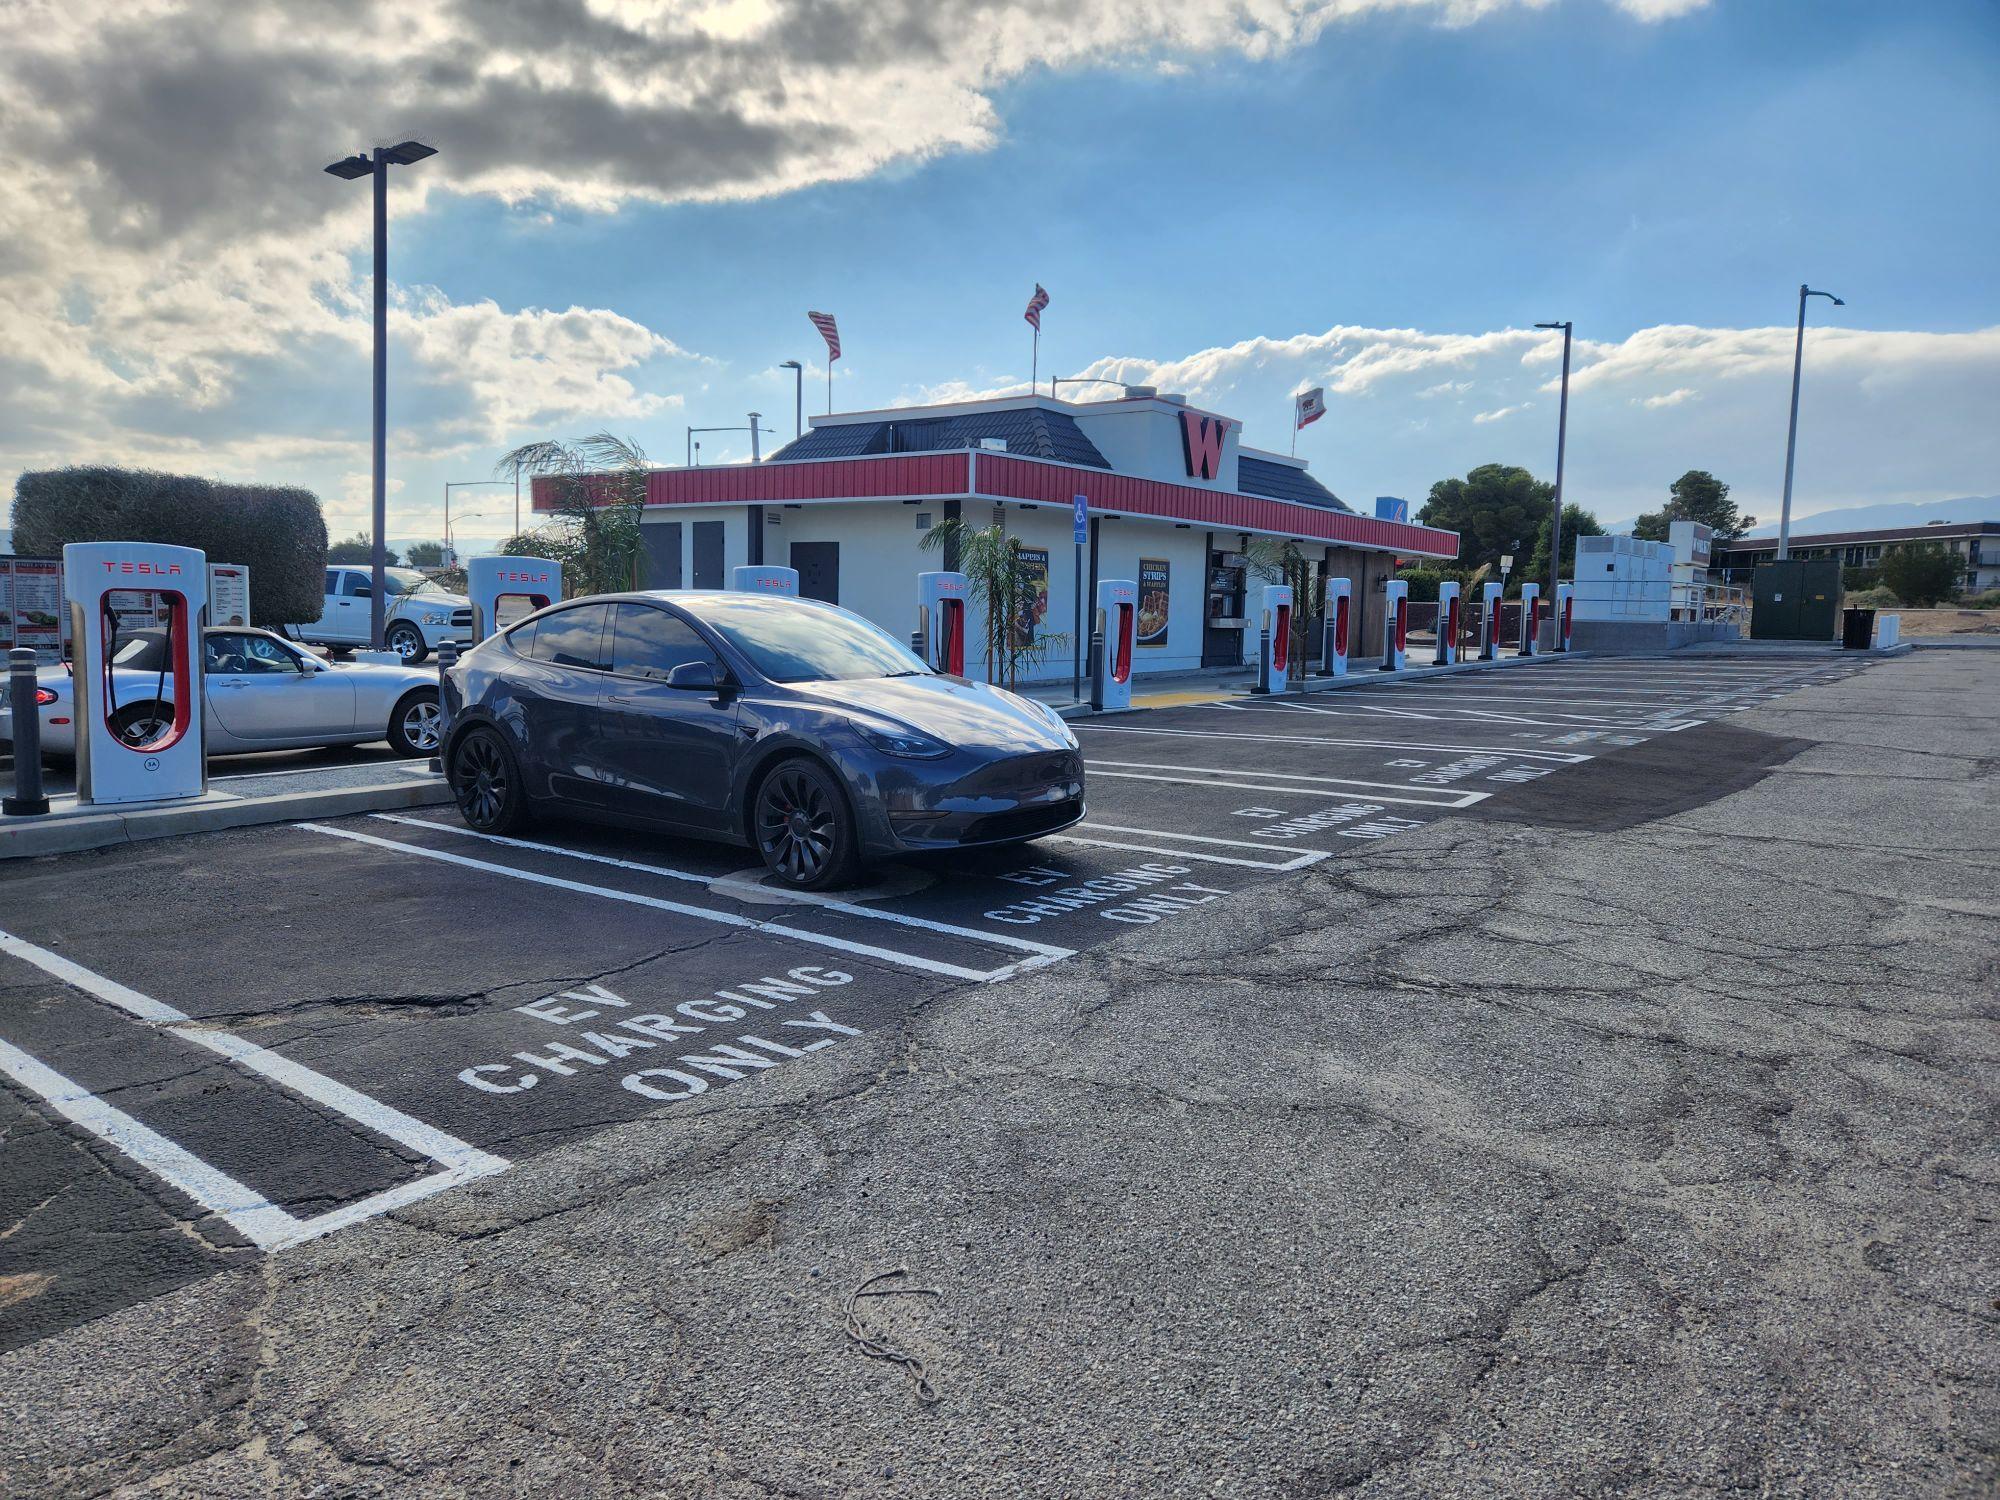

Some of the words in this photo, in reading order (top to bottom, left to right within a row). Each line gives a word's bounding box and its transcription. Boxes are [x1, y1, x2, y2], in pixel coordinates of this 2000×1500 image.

[1178, 411, 1231, 479] W
[102, 562, 181, 575] TESLA
[497, 572, 548, 583] TESLA
[1142, 571, 1167, 581] STRIPS
[1143, 563, 1167, 572] CHICKEN
[756, 579, 792, 588] TESLA
[1409, 754, 1508, 784] CHARGING
[1486, 764, 1557, 783] ONLY
[1230, 806, 1290, 819] EV
[1249, 803, 1385, 839] CHARGING
[1336, 816, 1429, 839] ONLY
[997, 866, 1072, 886] EV
[983, 863, 1191, 924] CHARGING
[1099, 882, 1232, 924] ONLY
[513, 984, 632, 1025] EV
[457, 966, 853, 1094] CHARGING
[621, 1010, 864, 1101] ONLY
